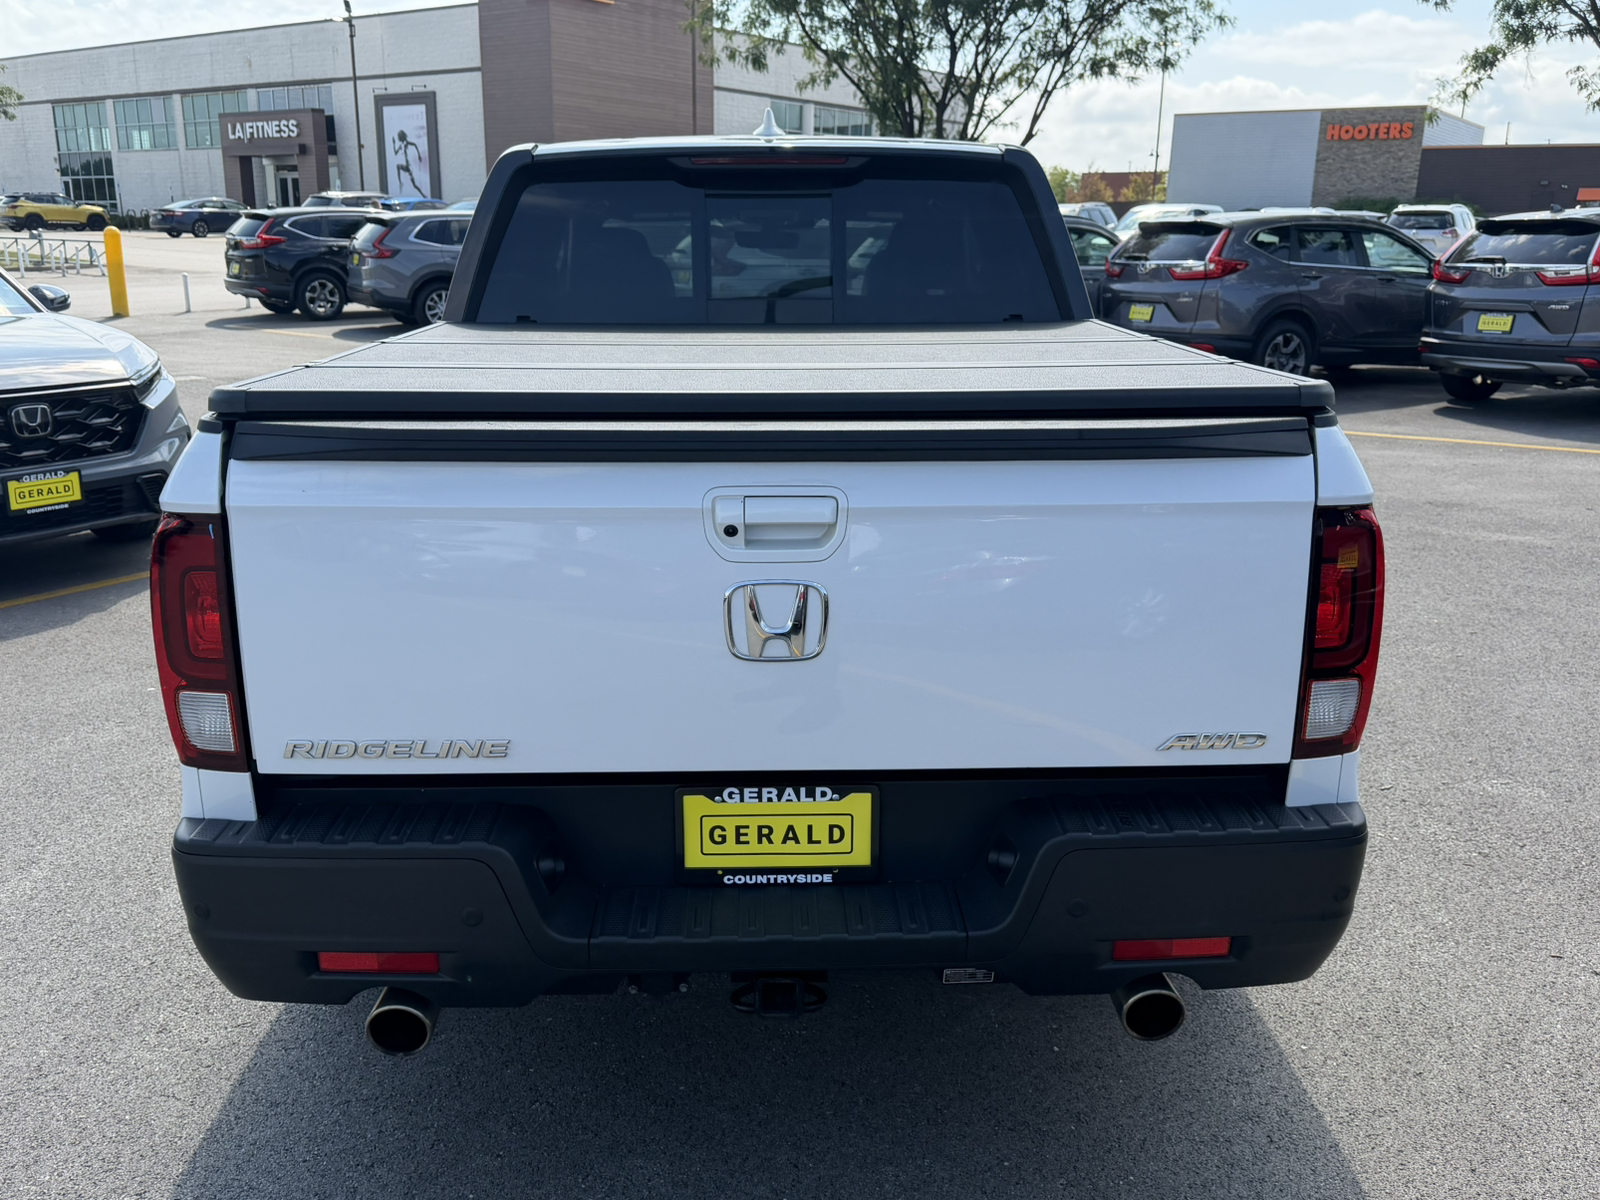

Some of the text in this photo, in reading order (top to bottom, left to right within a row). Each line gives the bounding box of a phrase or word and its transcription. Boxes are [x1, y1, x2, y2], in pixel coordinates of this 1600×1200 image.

[1326, 121, 1414, 141] HOOTERS
[22, 470, 65, 483] GERALD
[18, 484, 71, 500] GERALD
[26, 503, 69, 515] COUNTRYSIDE
[283, 739, 511, 759] RIDGELINE
[1156, 731, 1267, 751] AWD
[722, 787, 833, 803] GERALD
[708, 824, 846, 845] GERALD
[723, 873, 833, 885] COUNTRYSIDE
